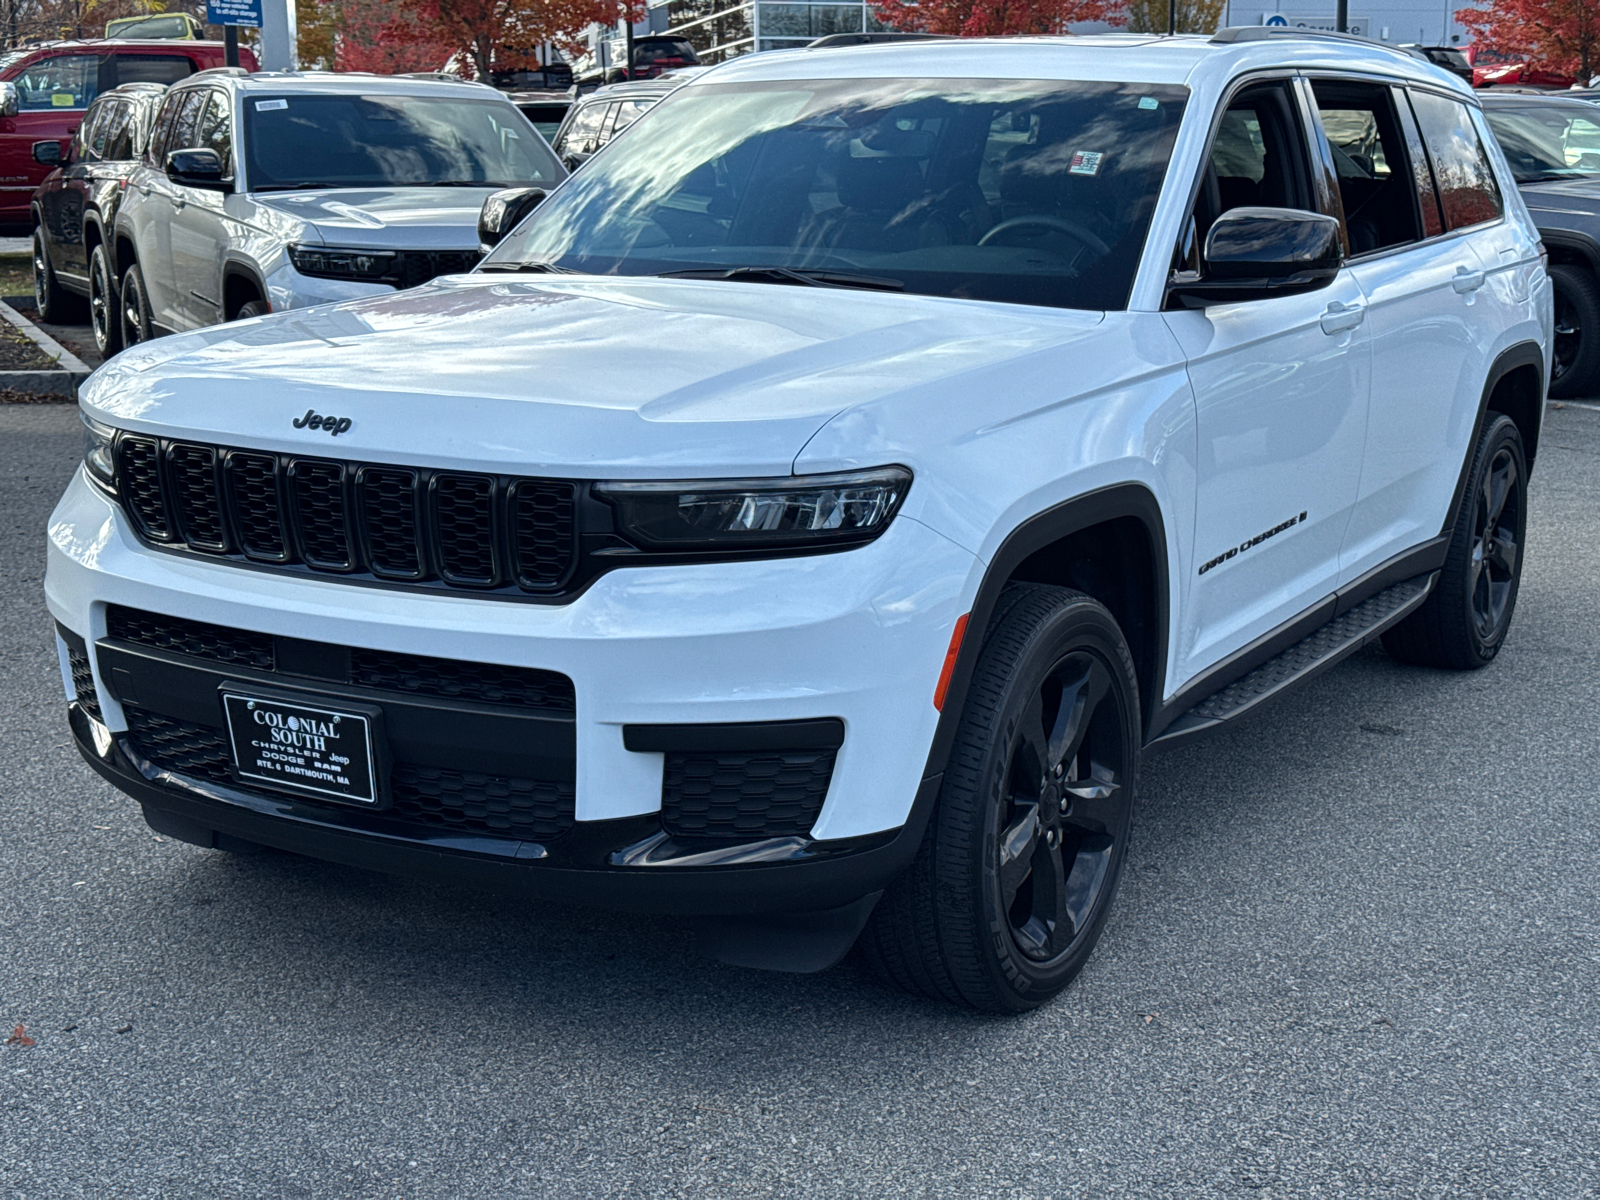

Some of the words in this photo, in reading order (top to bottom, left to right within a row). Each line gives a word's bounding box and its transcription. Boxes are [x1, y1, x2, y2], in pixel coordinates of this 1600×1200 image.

[292, 409, 353, 437] Jeep
[1198, 546, 1239, 576] GRAND
[270, 727, 327, 752] SOUTH
[251, 740, 321, 759] CHRYSLER
[328, 752, 350, 766] Jeep
[261, 750, 305, 765] DODGE
[313, 761, 342, 772] RAM
[275, 763, 282, 771] 6
[284, 764, 336, 784] DARTMOUTH,
[336, 775, 350, 785] MA
